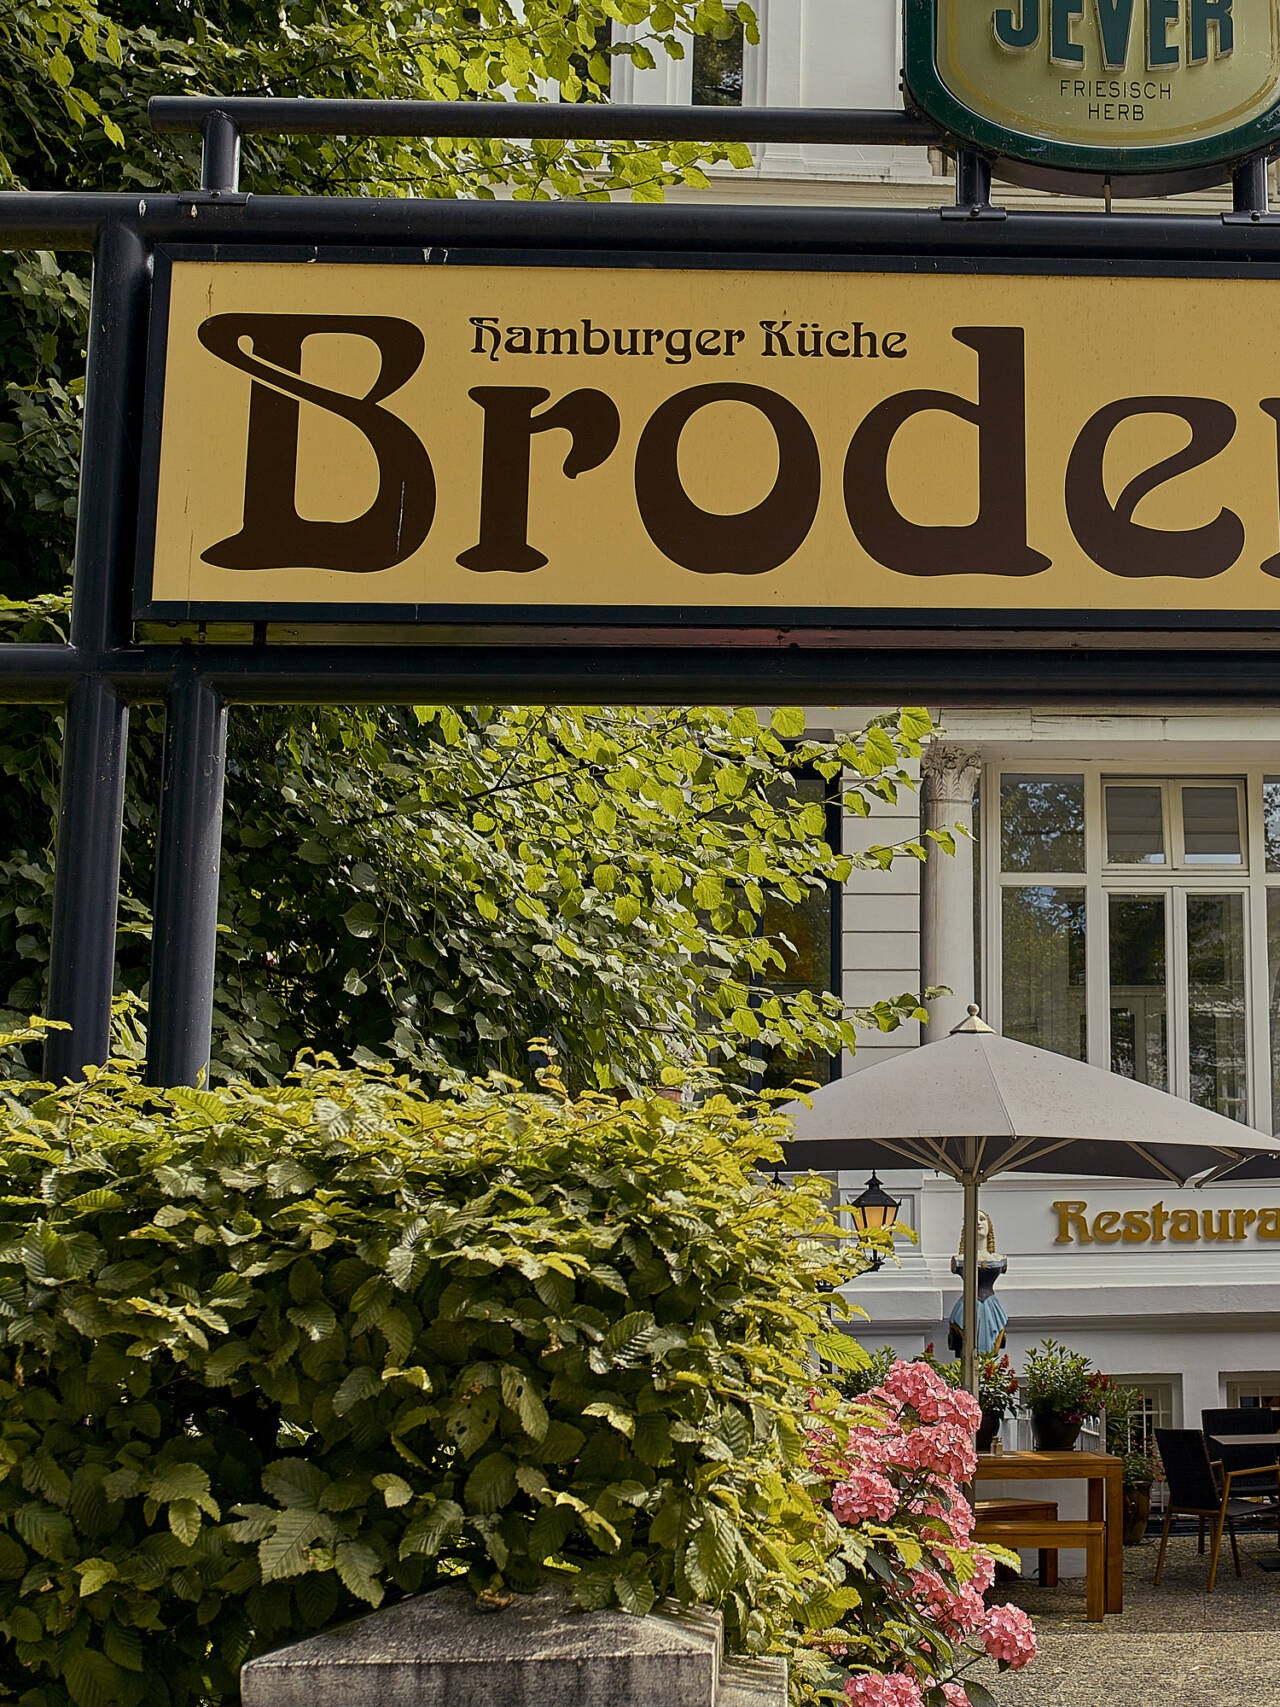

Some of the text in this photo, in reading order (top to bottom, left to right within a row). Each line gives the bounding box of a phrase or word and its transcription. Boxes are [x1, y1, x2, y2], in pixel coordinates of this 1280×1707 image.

[1060, 79, 1171, 100] FRIESISCH
[1088, 102, 1144, 121] HERB
[468, 316, 908, 365] Hamburger Küche
